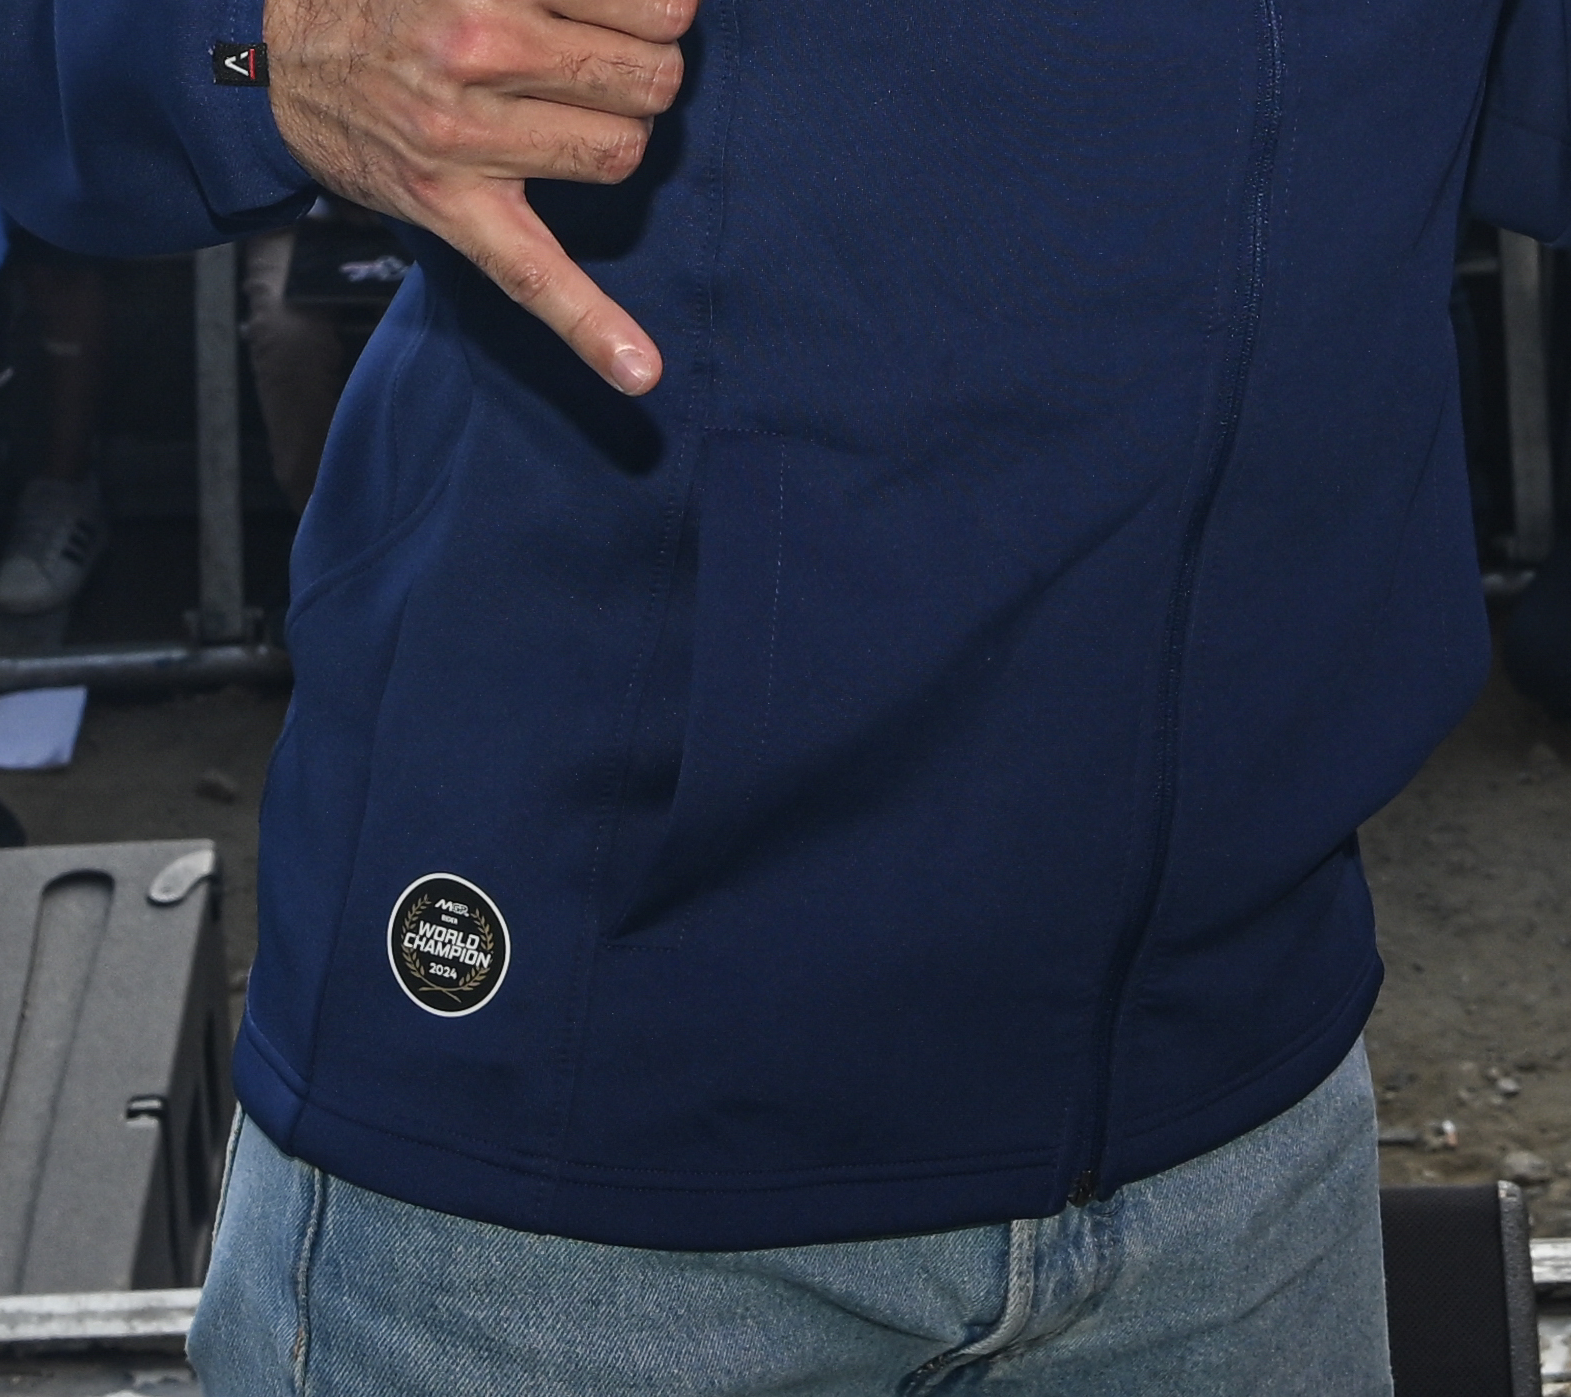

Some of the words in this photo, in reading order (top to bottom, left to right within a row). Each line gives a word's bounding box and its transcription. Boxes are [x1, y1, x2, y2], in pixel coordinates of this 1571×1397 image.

[402, 931, 493, 970] CHAMPION
[418, 920, 480, 951] WORLD
[428, 962, 459, 981] 2024
